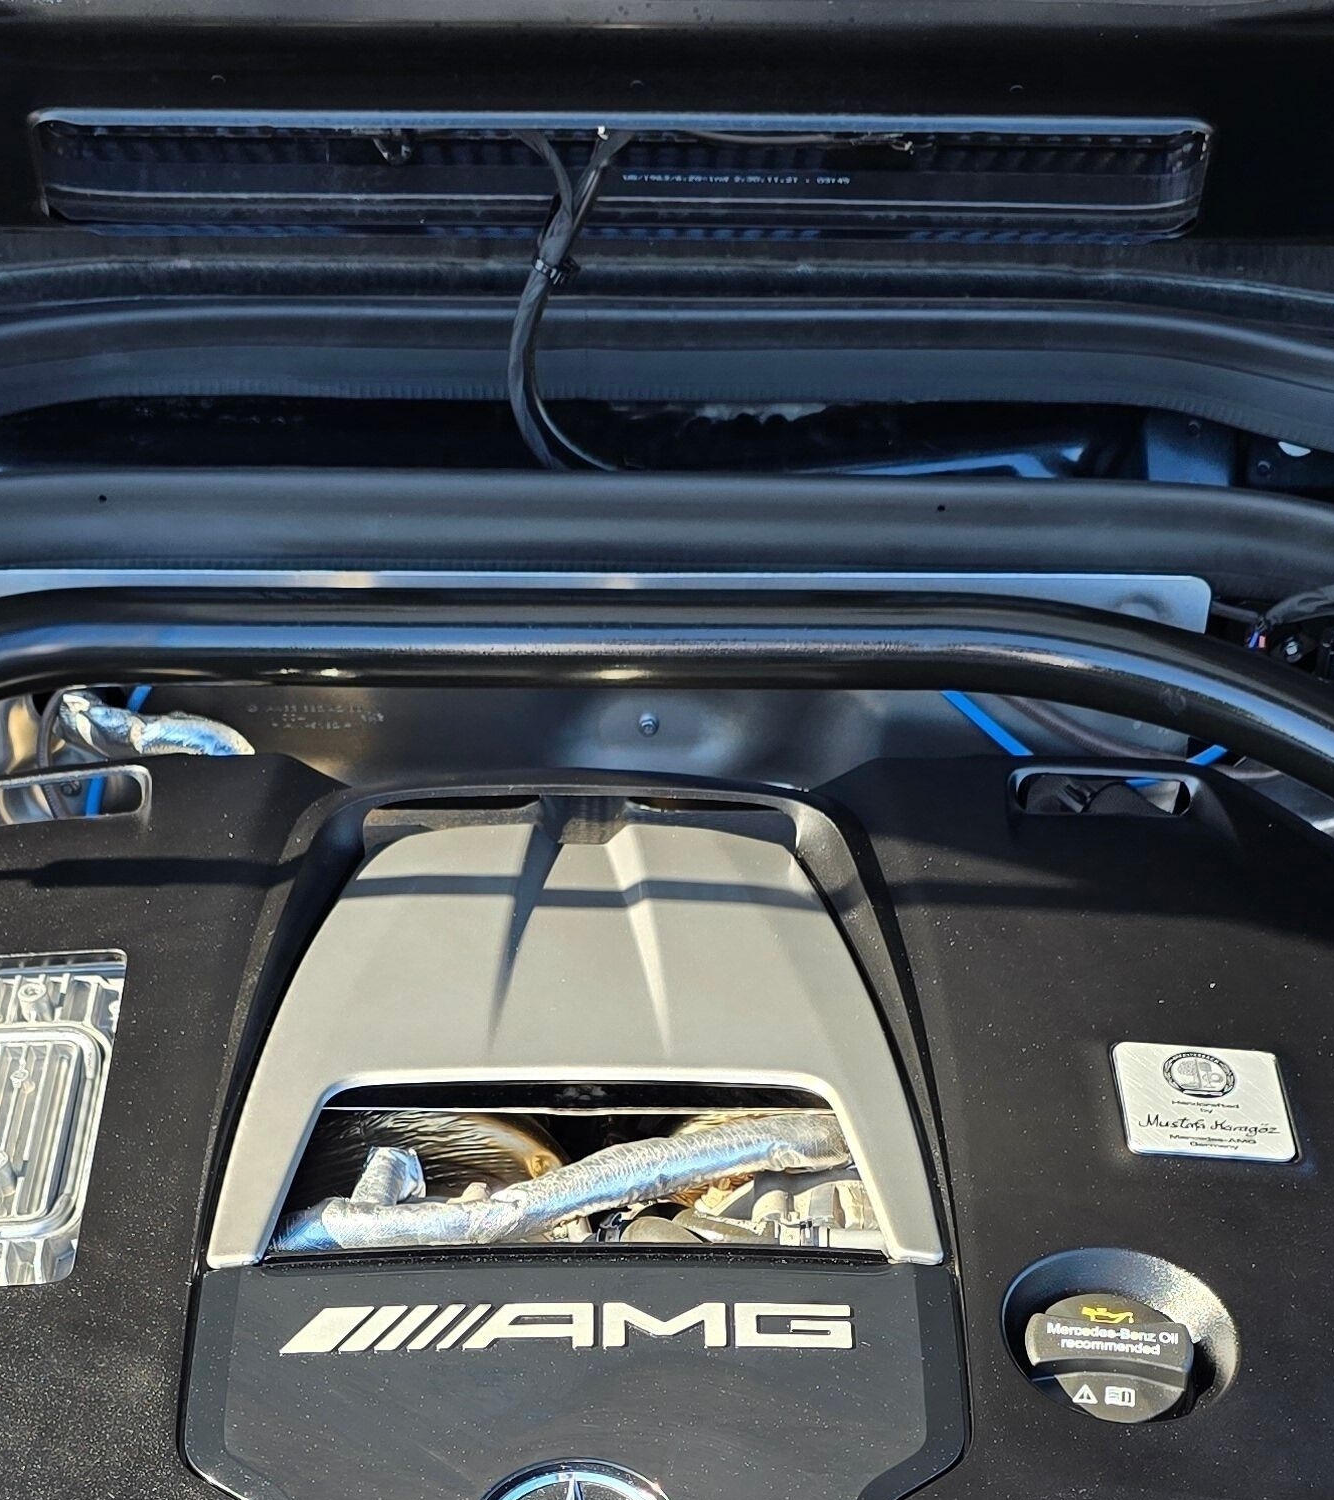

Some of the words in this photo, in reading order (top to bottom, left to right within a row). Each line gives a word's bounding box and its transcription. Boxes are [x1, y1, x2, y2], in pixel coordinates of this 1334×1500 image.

[1169, 1133, 1257, 1145] Mercedes-AMG
[1190, 1141, 1239, 1150] Germany
[461, 1301, 855, 1351] AMG
[1046, 1322, 1157, 1343] Mercedes-Benz
[1158, 1331, 1179, 1345] Oil
[1060, 1338, 1161, 1356] recommended
